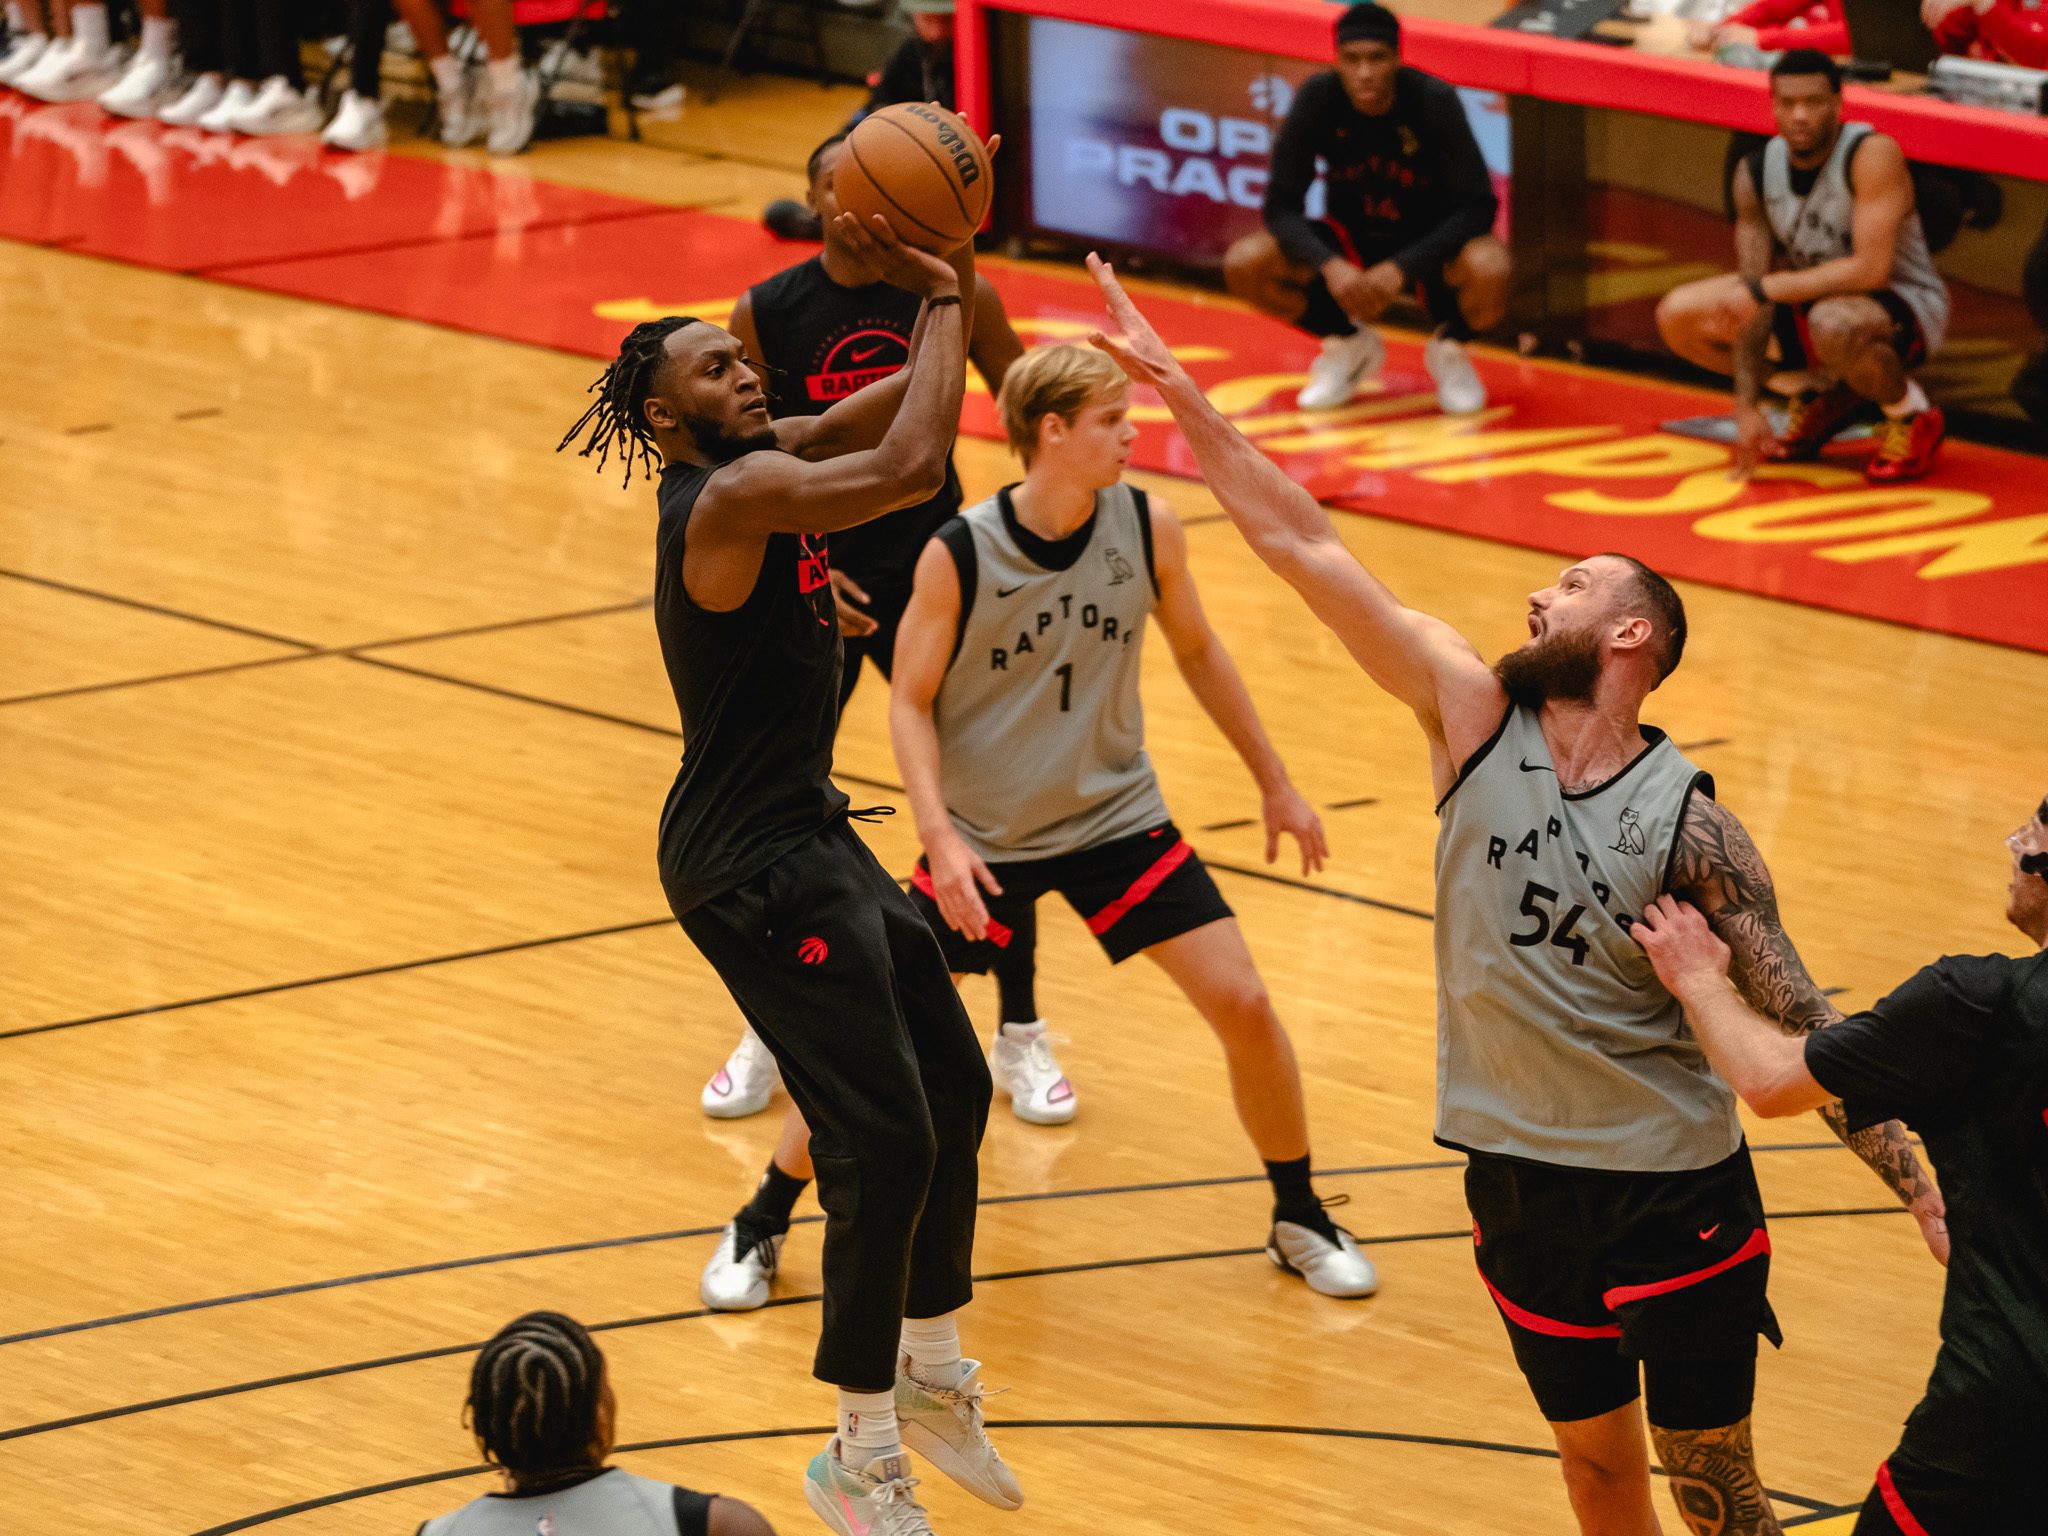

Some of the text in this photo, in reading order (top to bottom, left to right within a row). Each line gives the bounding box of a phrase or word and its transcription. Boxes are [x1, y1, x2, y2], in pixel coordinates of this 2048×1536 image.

[906, 104, 980, 189] Wilson
[1055, 662, 1073, 712] 1
[1509, 880, 1591, 966] 54
